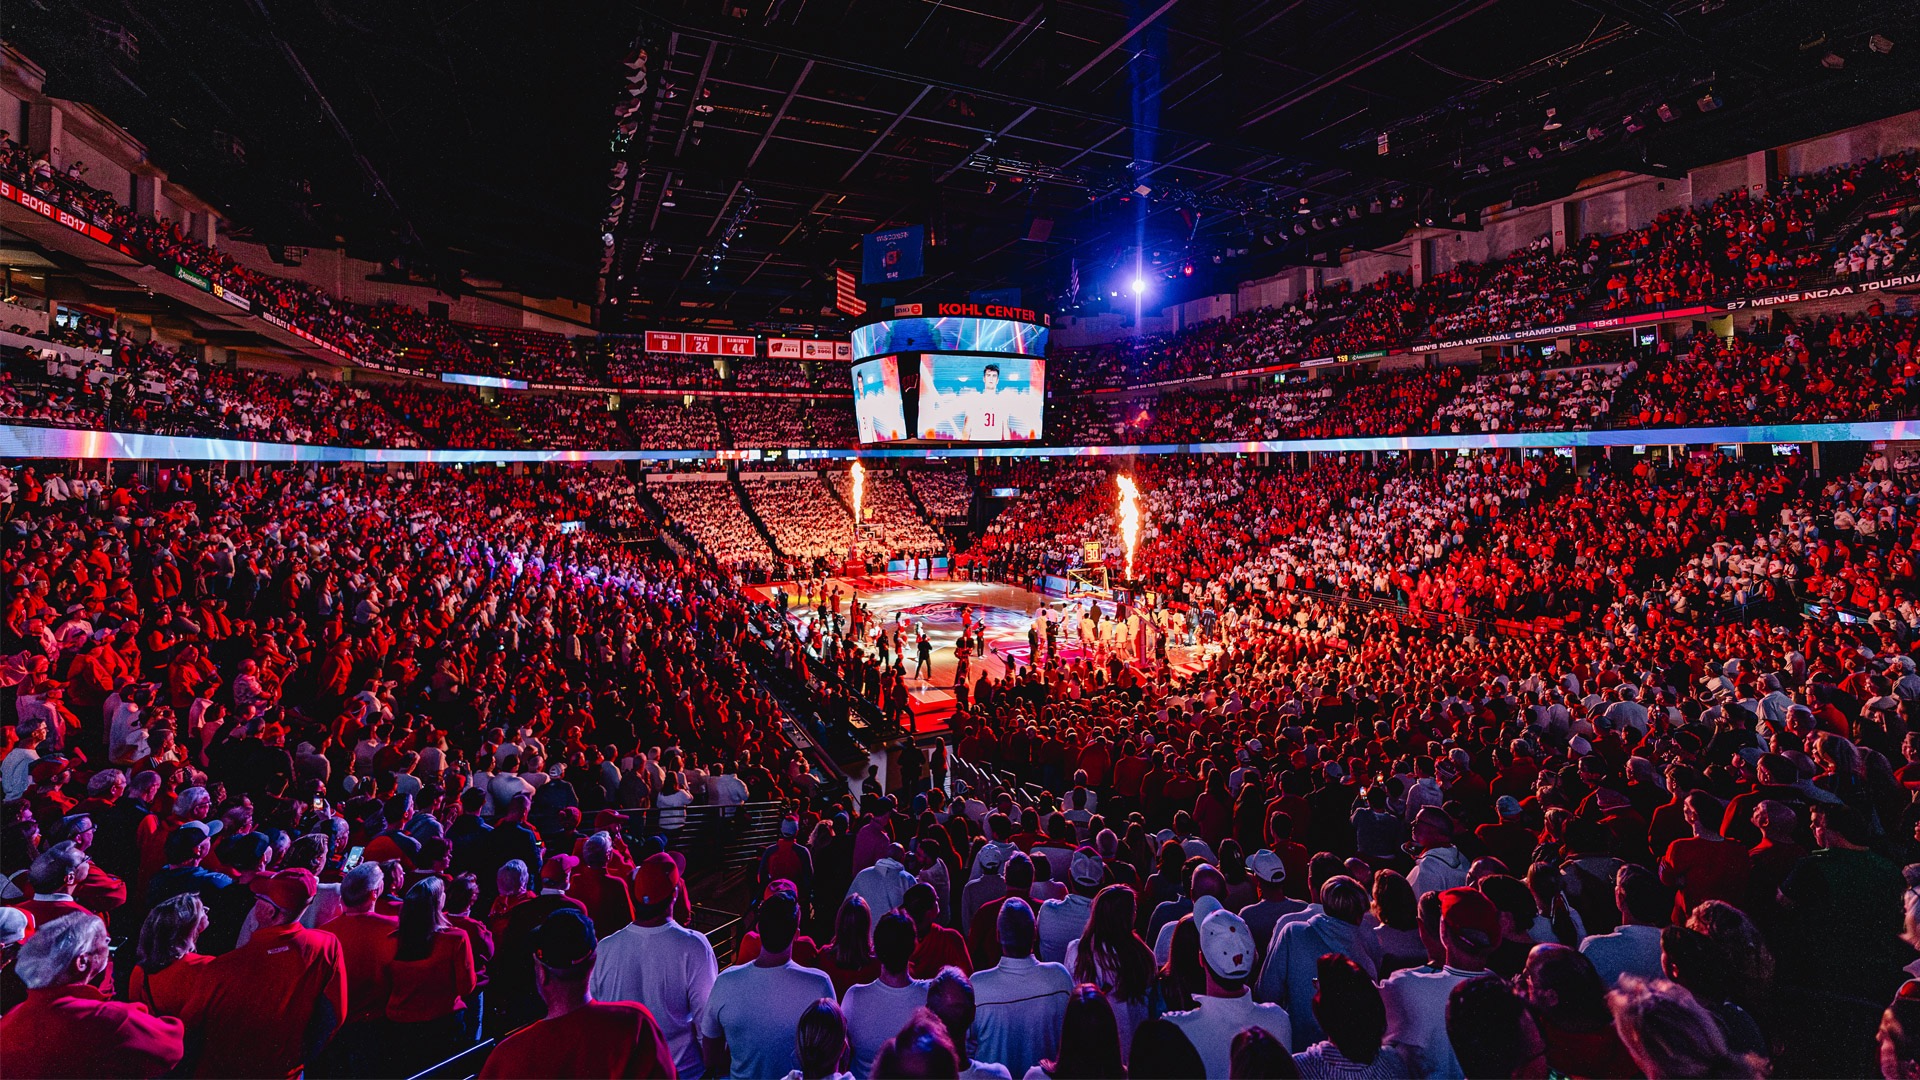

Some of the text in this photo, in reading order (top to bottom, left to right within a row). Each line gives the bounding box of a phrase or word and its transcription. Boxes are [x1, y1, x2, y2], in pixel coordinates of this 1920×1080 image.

[21, 193, 51, 217] 2016
[60, 212, 86, 233] 2017
[1727, 301, 1746, 310] 27
[1751, 293, 1799, 307] MEN'S
[1804, 286, 1853, 300] NCAA
[939, 303, 1036, 322] KOHL CENTER
[1412, 318, 1618, 352] MEN'S NCAA NATIONAL CHAMPIONS 1941
[695, 342, 708, 353] 24
[732, 343, 744, 354] 44
[984, 412, 995, 427] 31
[1087, 549, 1098, 560] 30
